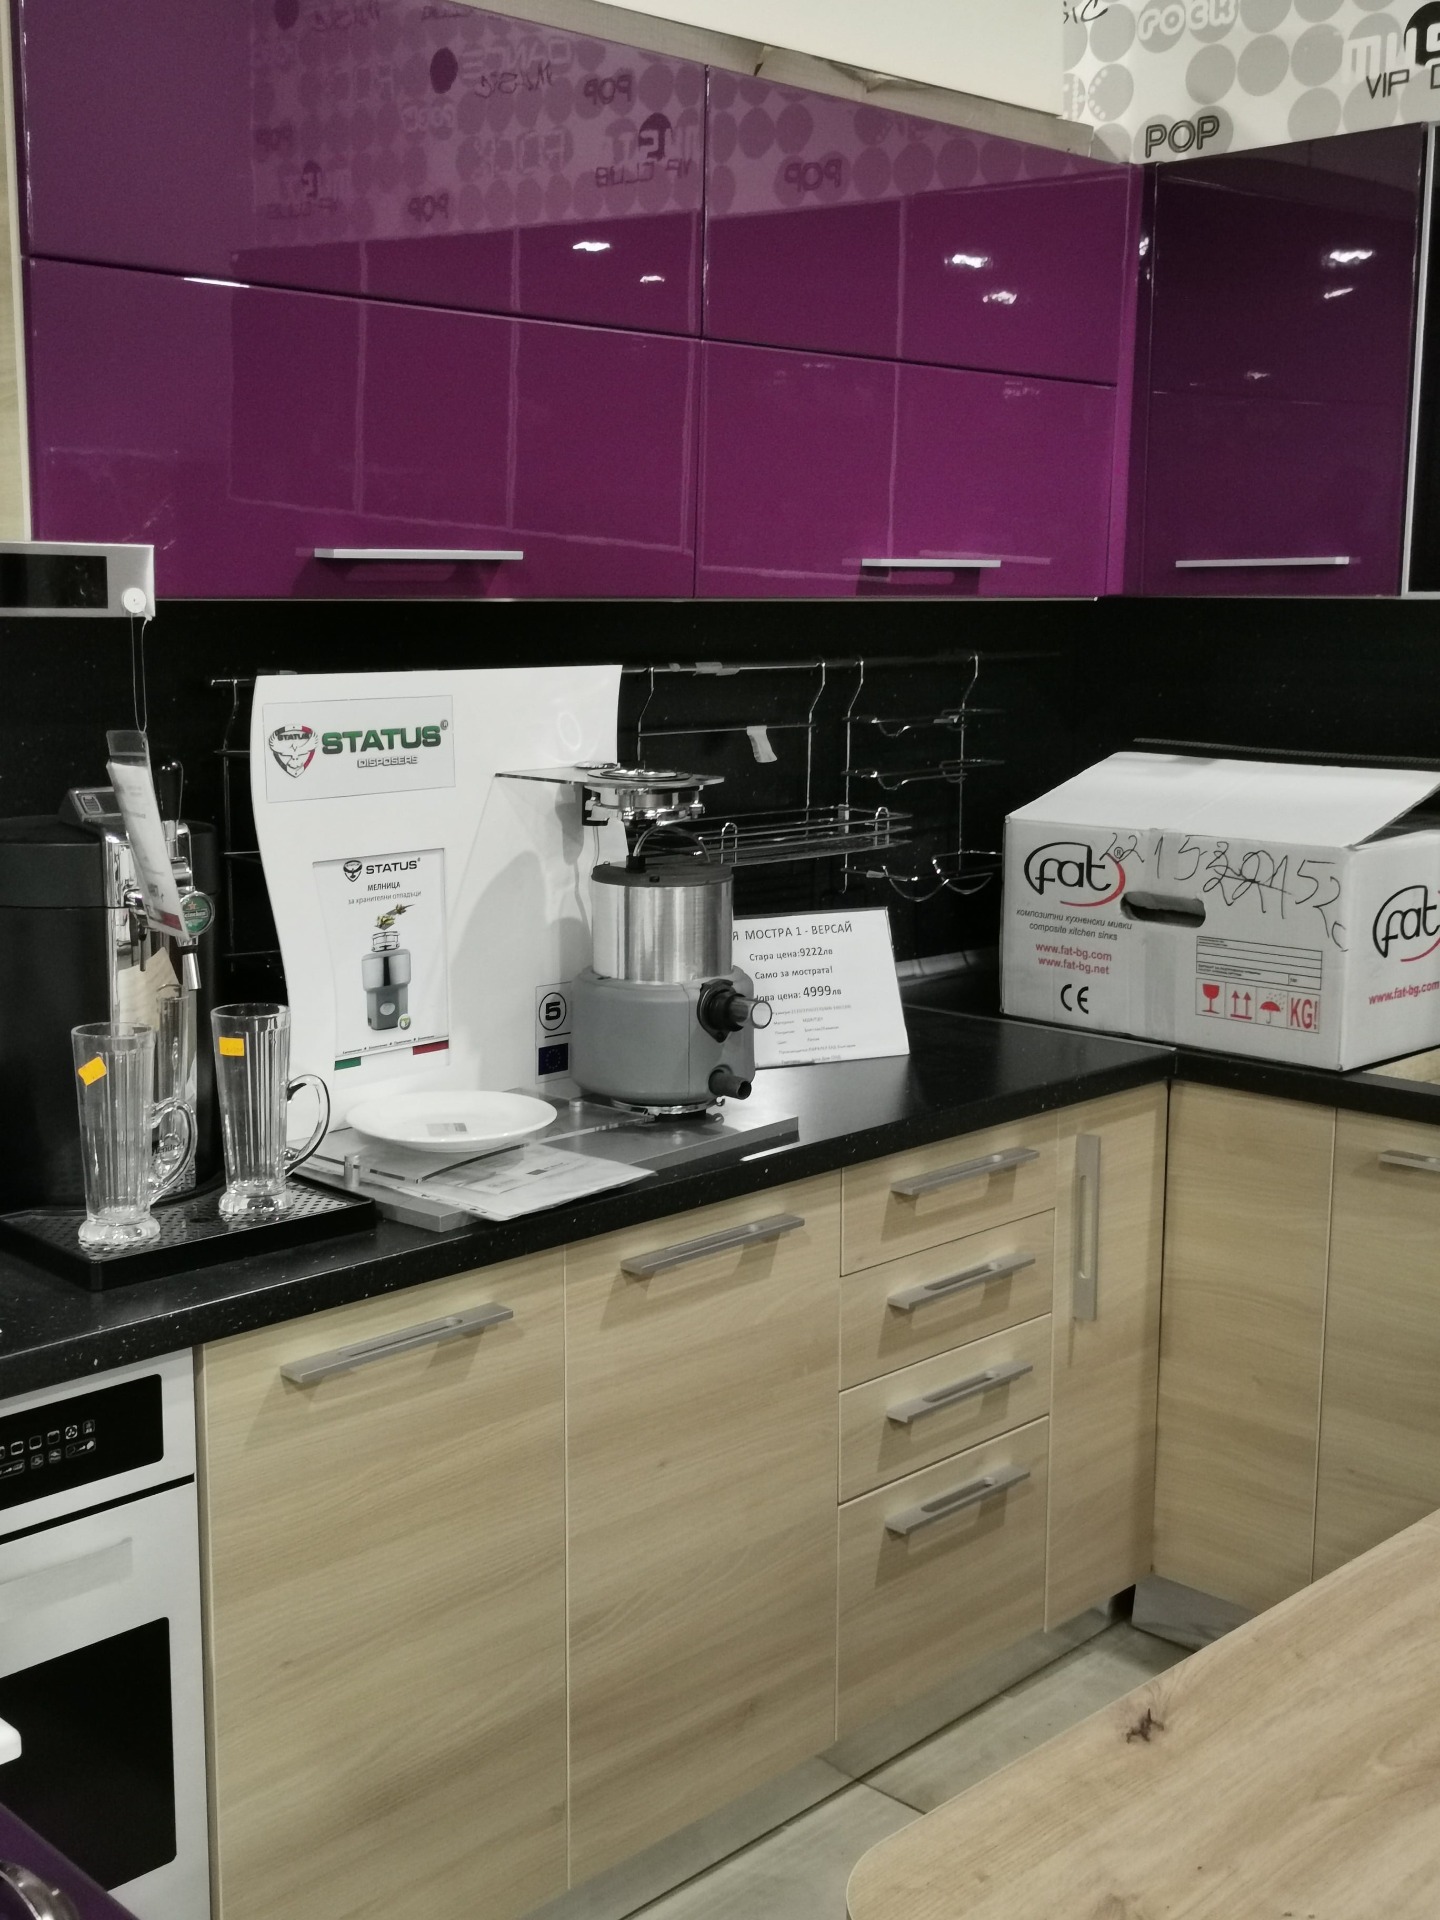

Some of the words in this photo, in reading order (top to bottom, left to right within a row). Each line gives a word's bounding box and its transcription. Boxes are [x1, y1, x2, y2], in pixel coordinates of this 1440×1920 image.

[1366, 68, 1410, 99] VIP
[1144, 115, 1220, 158] POP
[321, 725, 442, 755] STATUS
[357, 755, 419, 769] DISPOSERS
[365, 860, 418, 875] STATUS
[1023, 841, 1113, 896] fat
[367, 881, 401, 892] МЕЛНИЦА
[745, 927, 793, 940] МОСТРА
[796, 926, 802, 936] 1
[811, 920, 853, 935] ВЕРСАЙ
[1372, 884, 1440, 958] fat
[1029, 922, 1067, 934] composite
[1068, 927, 1096, 938] kitchen
[1098, 930, 1118, 941] sinks
[749, 952, 774, 962] Стара
[1035, 943, 1112, 962] www.fat-bg.com
[754, 971, 778, 980] Само
[780, 969, 790, 978] за
[791, 965, 833, 977] мострата!
[1038, 956, 1110, 975] www.fat-bg.net
[777, 991, 801, 1001] цена:
[1368, 980, 1440, 1005] www.fat-bg.com
[1290, 997, 1318, 1030] KG!
